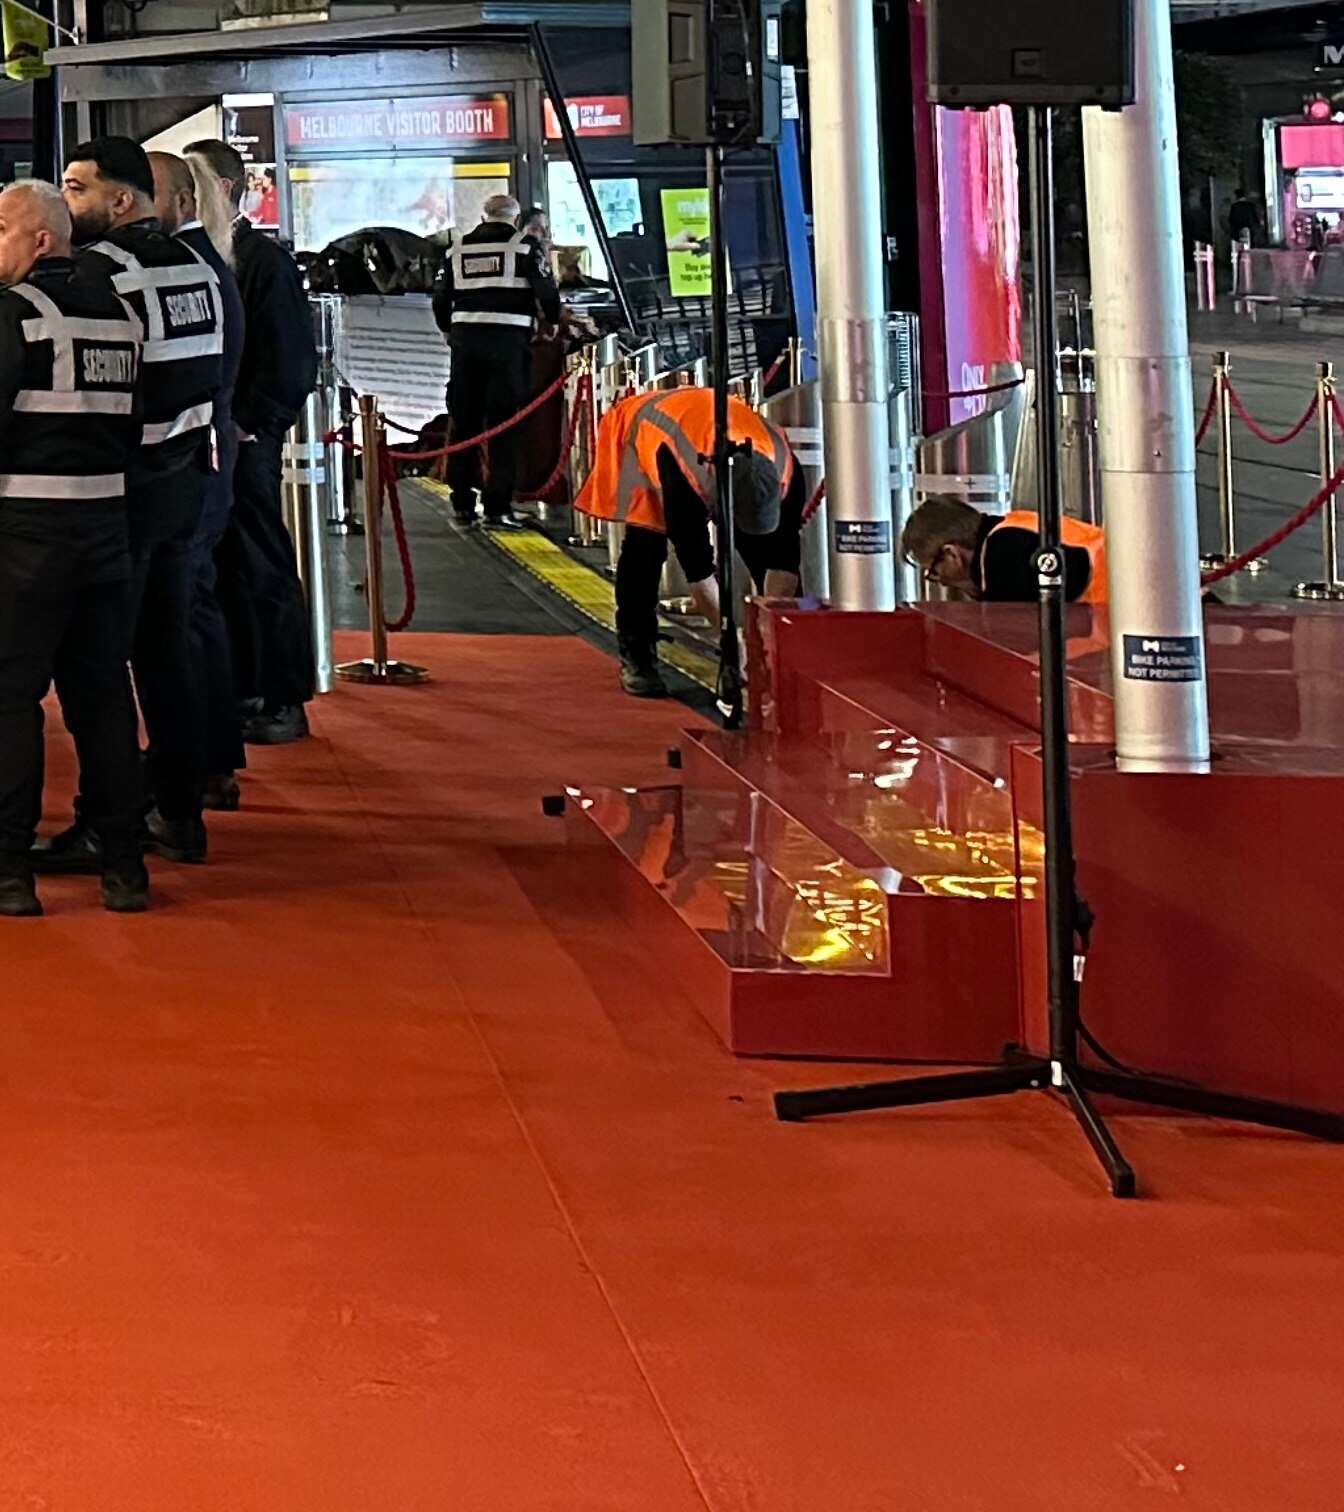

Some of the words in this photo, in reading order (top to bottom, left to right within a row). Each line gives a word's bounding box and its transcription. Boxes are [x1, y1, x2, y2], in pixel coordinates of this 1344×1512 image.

[300, 111, 384, 139] MELBOURNE
[386, 110, 442, 136] VISITOR
[445, 108, 494, 133] BOOTH
[165, 288, 212, 328] SECURITY
[82, 347, 134, 384] SECURITY
[1128, 667, 1147, 677] NOT
